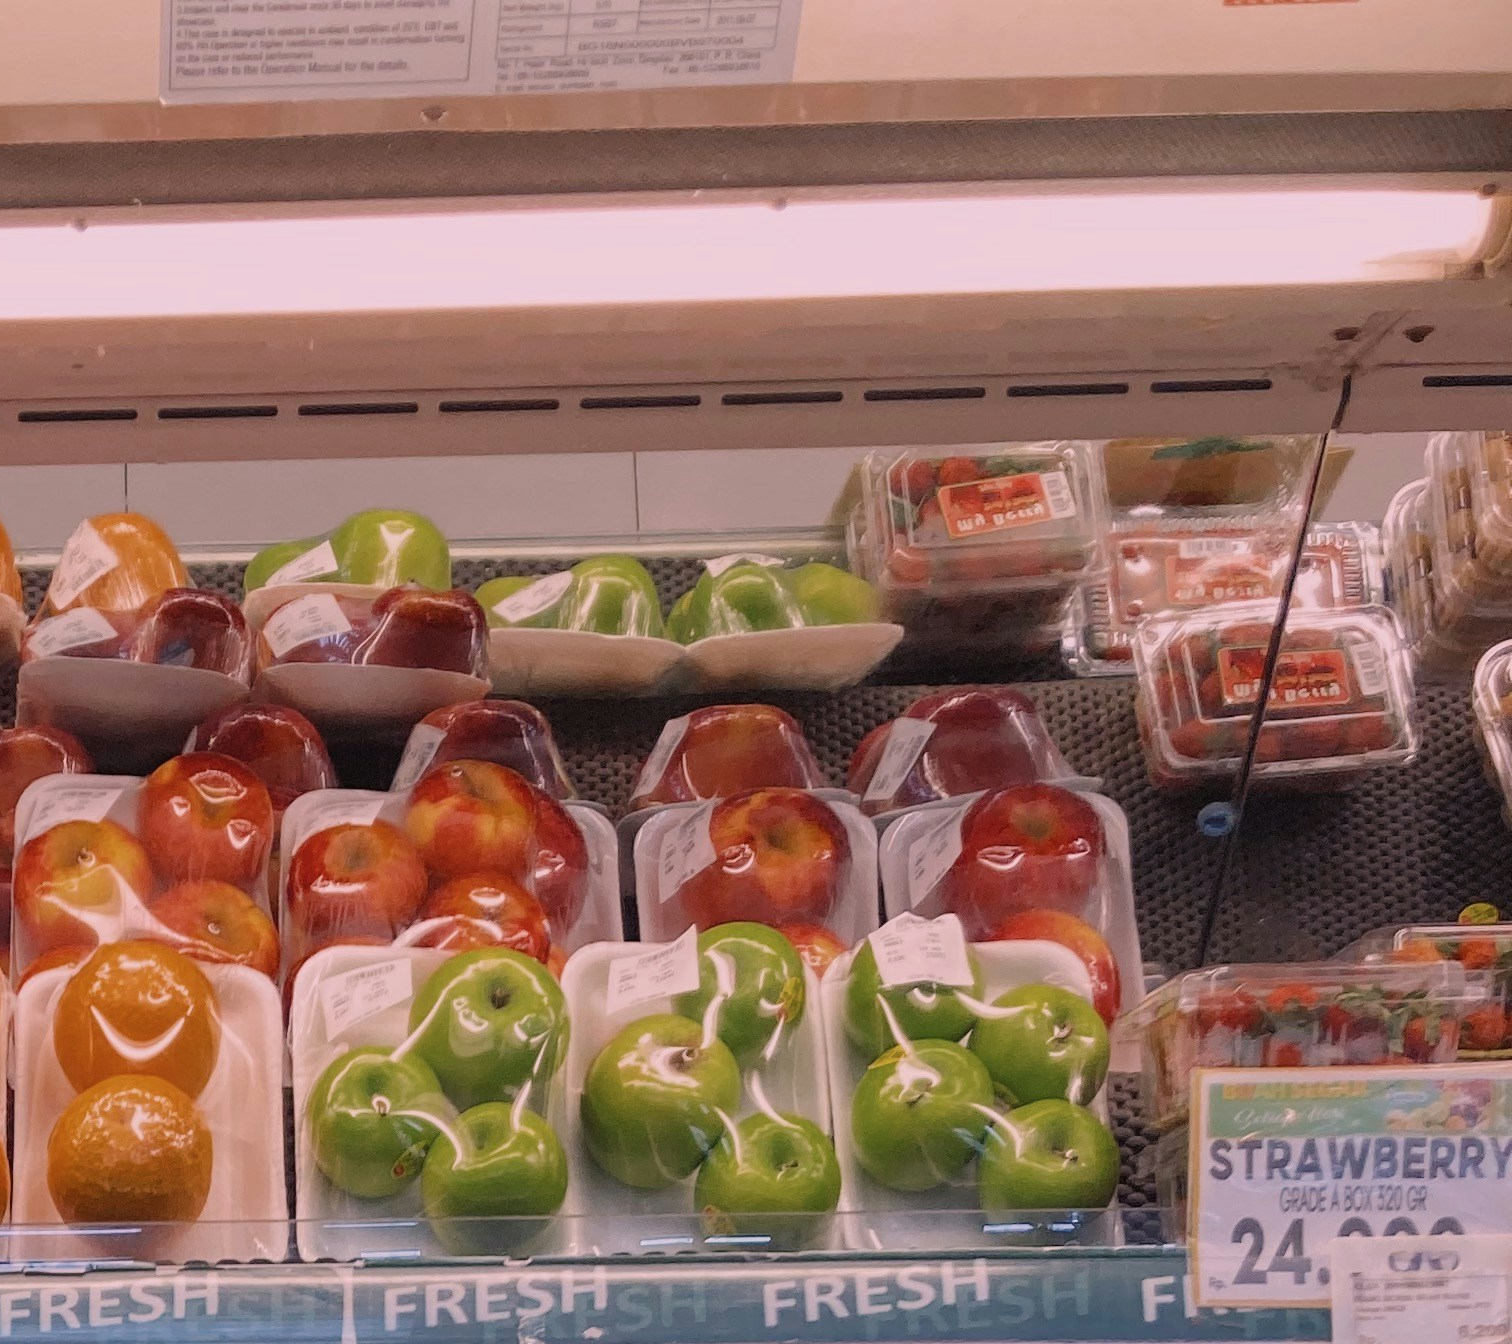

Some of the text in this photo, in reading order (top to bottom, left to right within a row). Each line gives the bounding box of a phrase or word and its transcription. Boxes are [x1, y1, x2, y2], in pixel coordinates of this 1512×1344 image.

[1279, 1185, 1327, 1213] GRADE
[1330, 1187, 1340, 1211] A
[1342, 1186, 1372, 1212] BOX
[1405, 1185, 1428, 1212] GR
[384, 1265, 608, 1333] FRESH
[762, 1258, 990, 1328] FRESH
